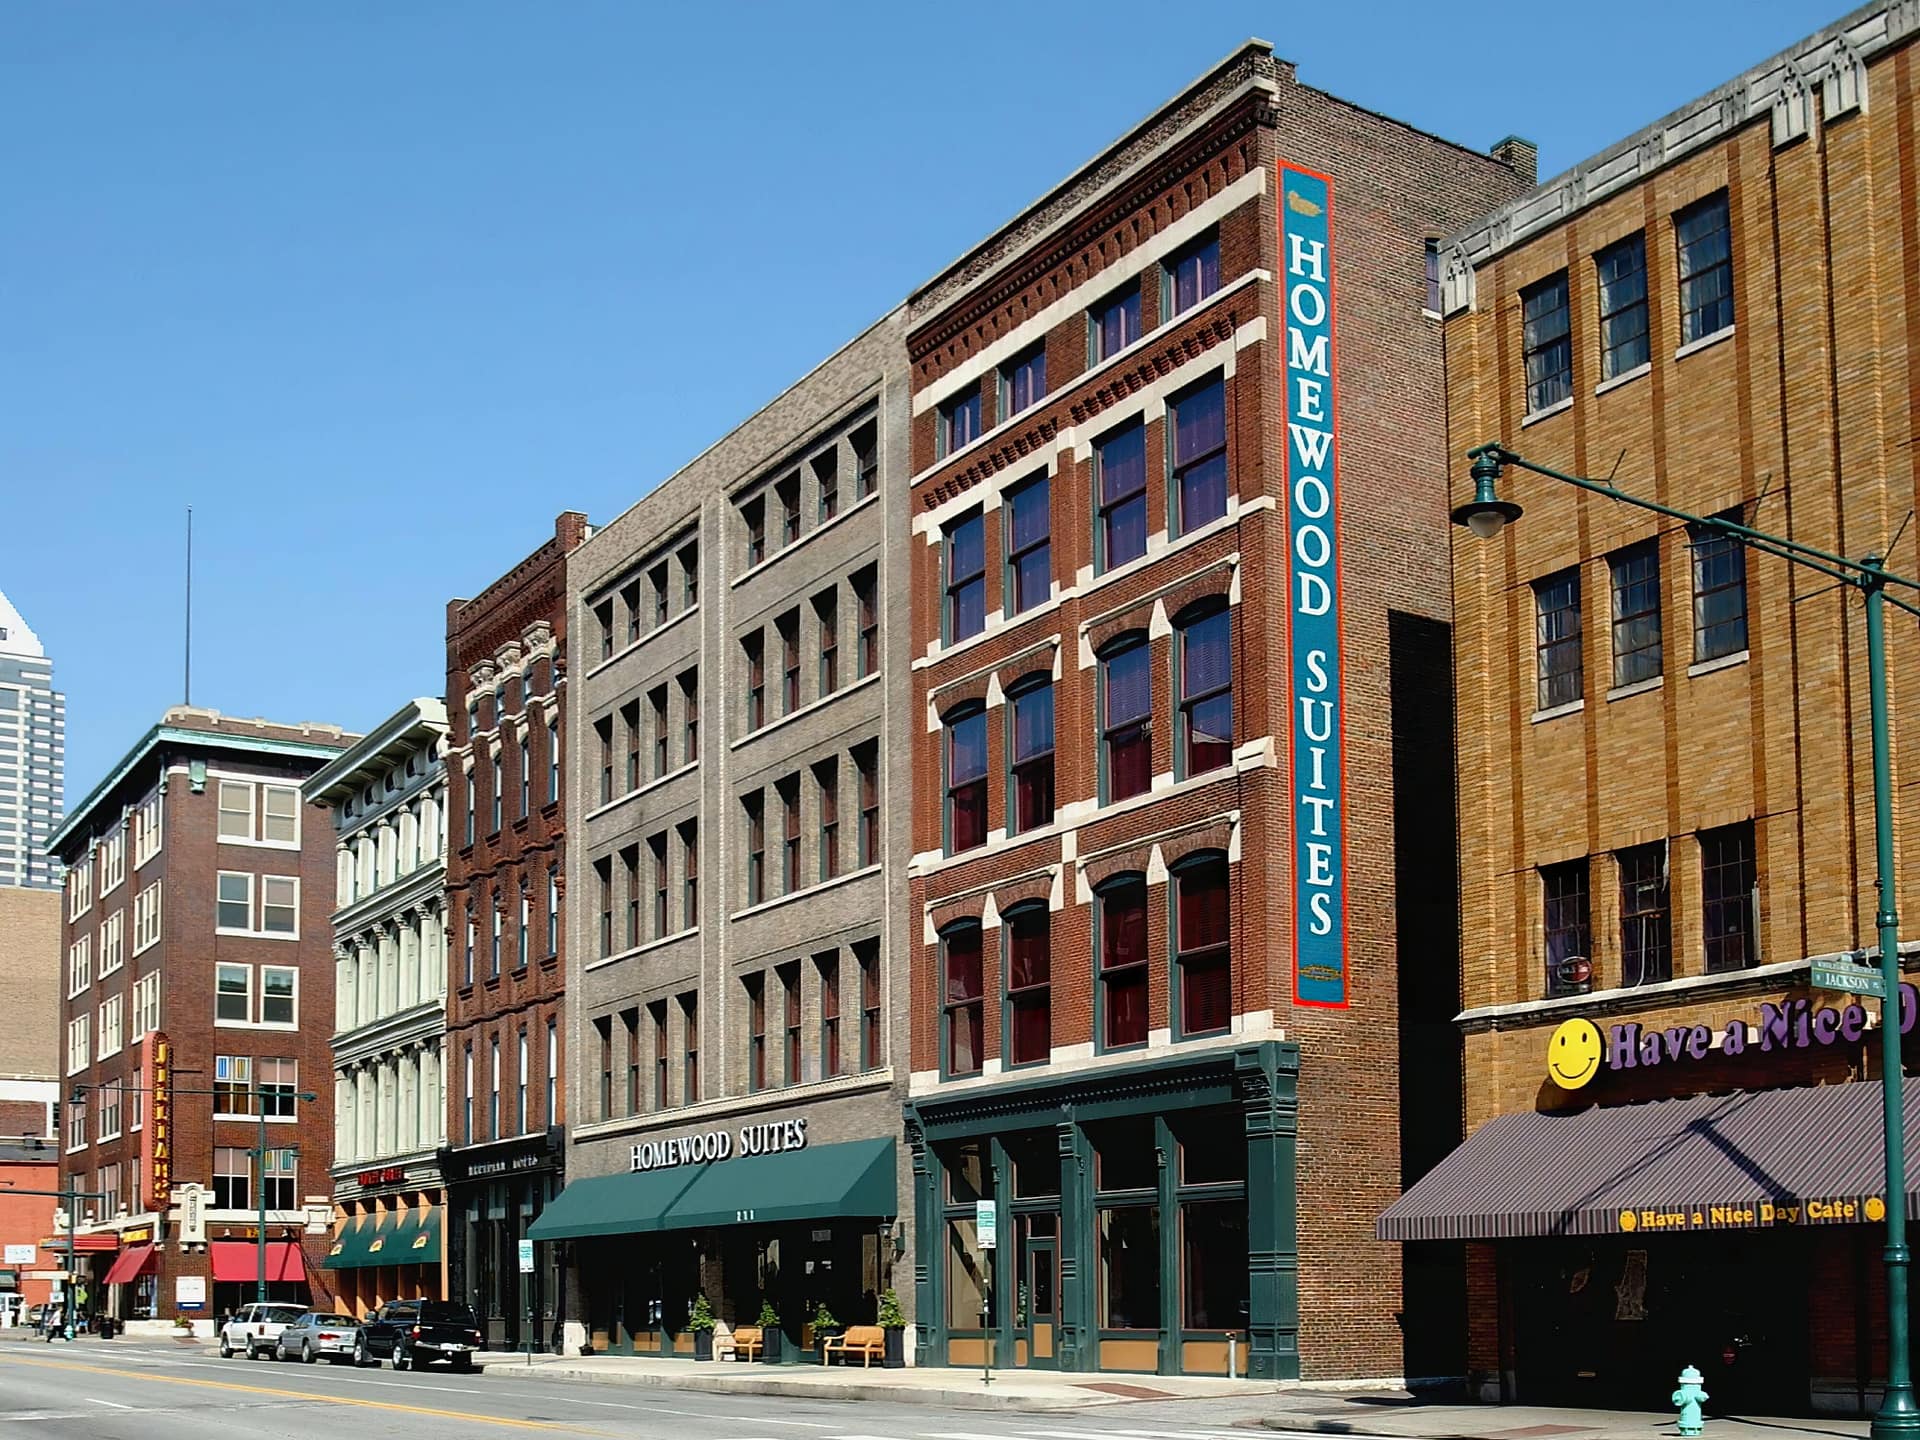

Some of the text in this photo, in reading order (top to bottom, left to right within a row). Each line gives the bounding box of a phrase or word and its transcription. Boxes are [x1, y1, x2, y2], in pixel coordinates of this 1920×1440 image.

[1287, 232, 1334, 616] HOMEWOOD
[1299, 649, 1334, 936] SUITES
[1825, 973, 1869, 990] JACKSON
[1610, 1023, 1708, 1070] Have
[1724, 1020, 1744, 1056] a
[1760, 999, 1862, 1052] Nice
[629, 1118, 806, 1171] HOMEWOOD SUITES
[1641, 1211, 1685, 1227] Have
[1692, 1211, 1704, 1225] a
[1710, 1207, 1753, 1224] Nice
[1760, 1204, 1799, 1223] Day
